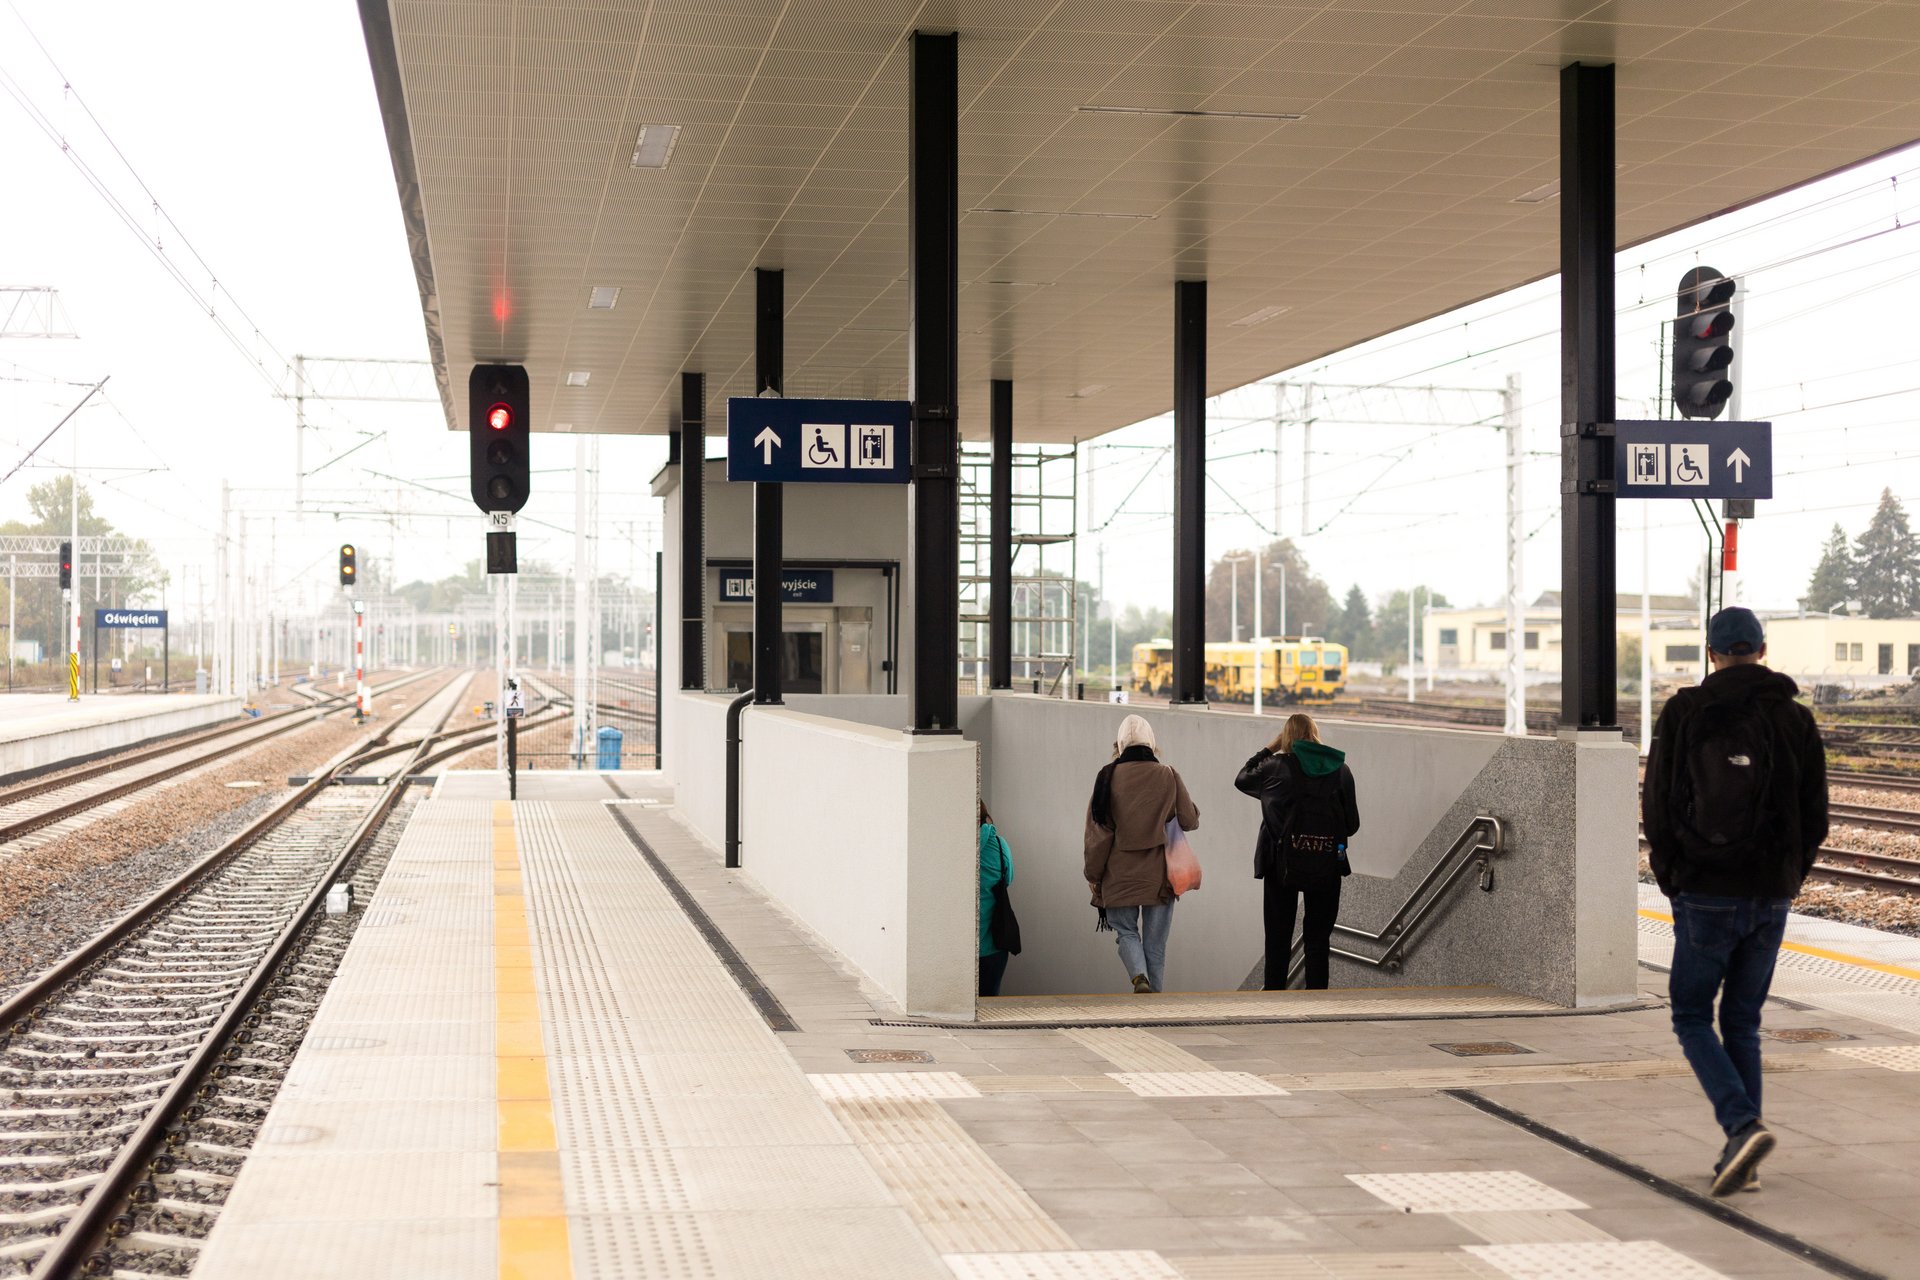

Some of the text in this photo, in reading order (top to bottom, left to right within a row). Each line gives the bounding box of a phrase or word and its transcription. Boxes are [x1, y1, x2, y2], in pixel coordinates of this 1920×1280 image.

[493, 514, 508, 525] N5
[105, 613, 158, 626] Oświęcim
[1291, 834, 1334, 852] VANS
